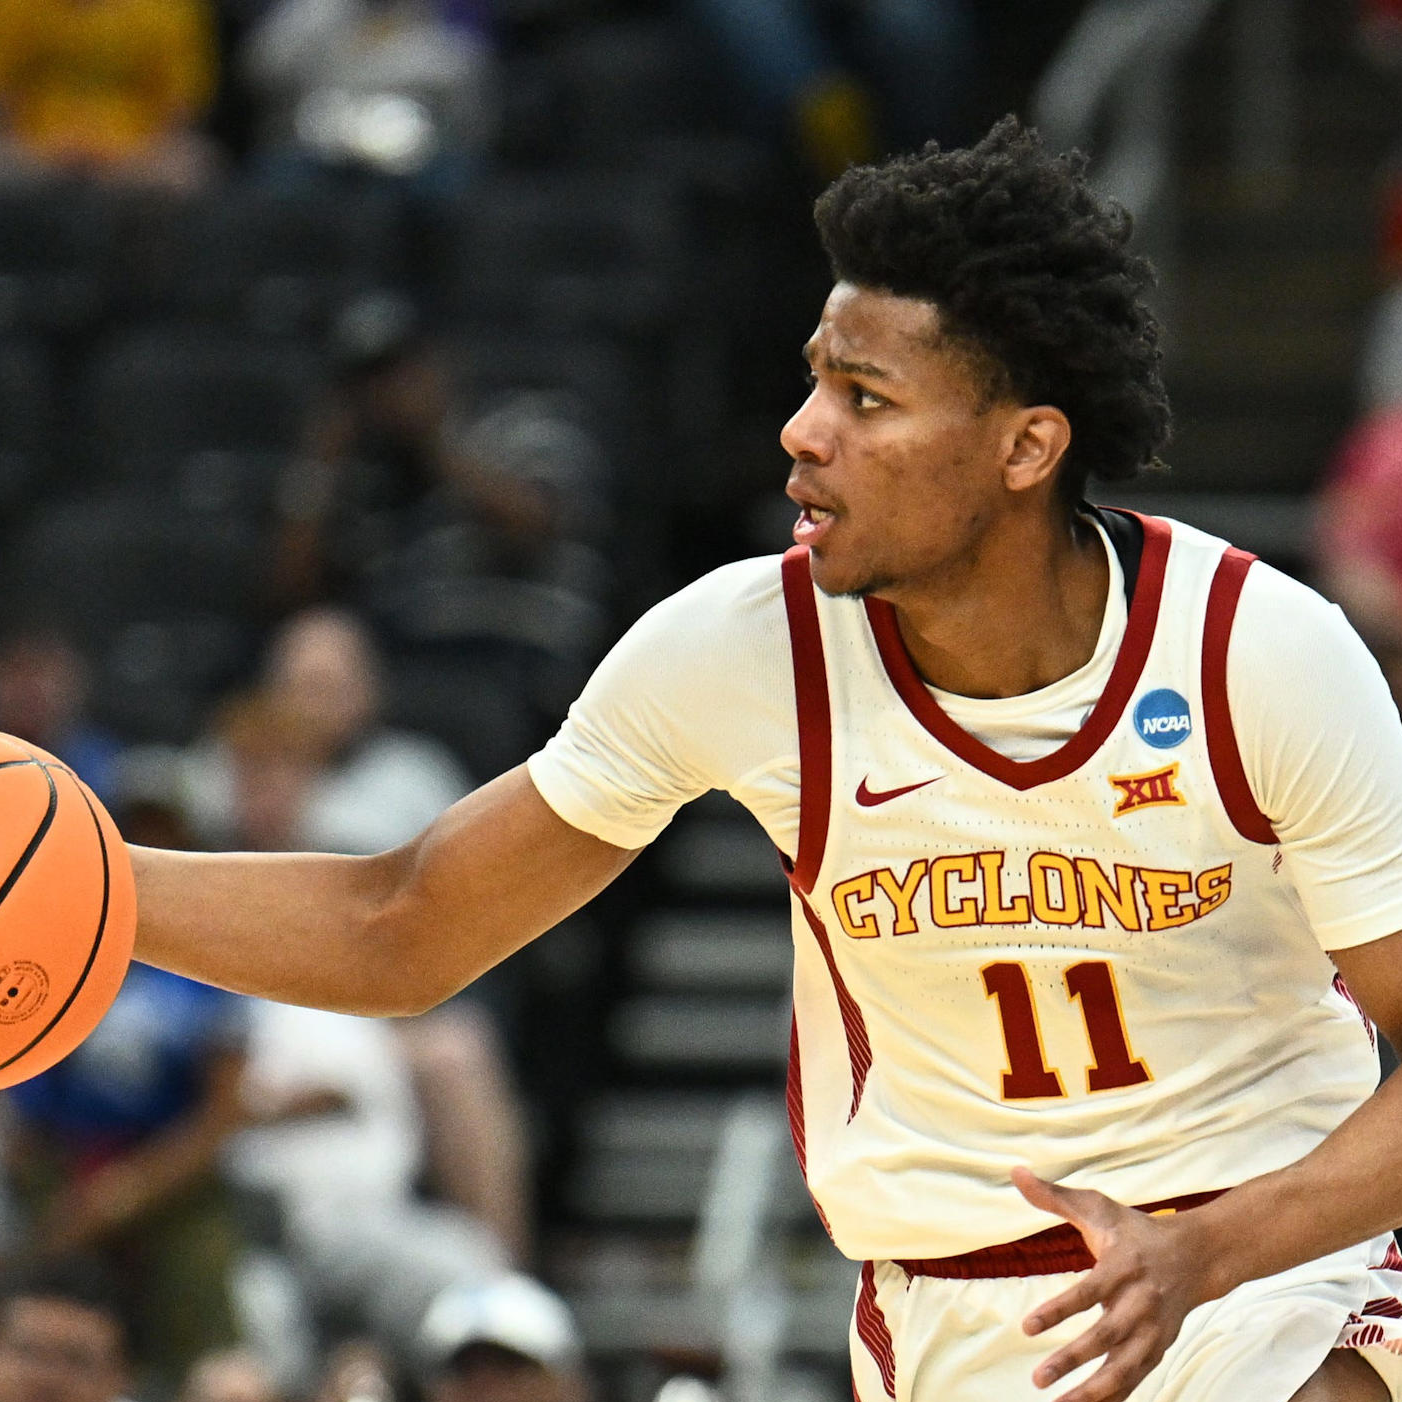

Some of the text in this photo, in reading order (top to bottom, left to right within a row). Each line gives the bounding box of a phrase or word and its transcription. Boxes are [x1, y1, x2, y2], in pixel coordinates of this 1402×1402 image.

[1142, 714, 1191, 735] NCAA
[1109, 763, 1184, 816] XII
[831, 850, 1233, 940] CYCLONES
[978, 960, 1155, 1101] 11
